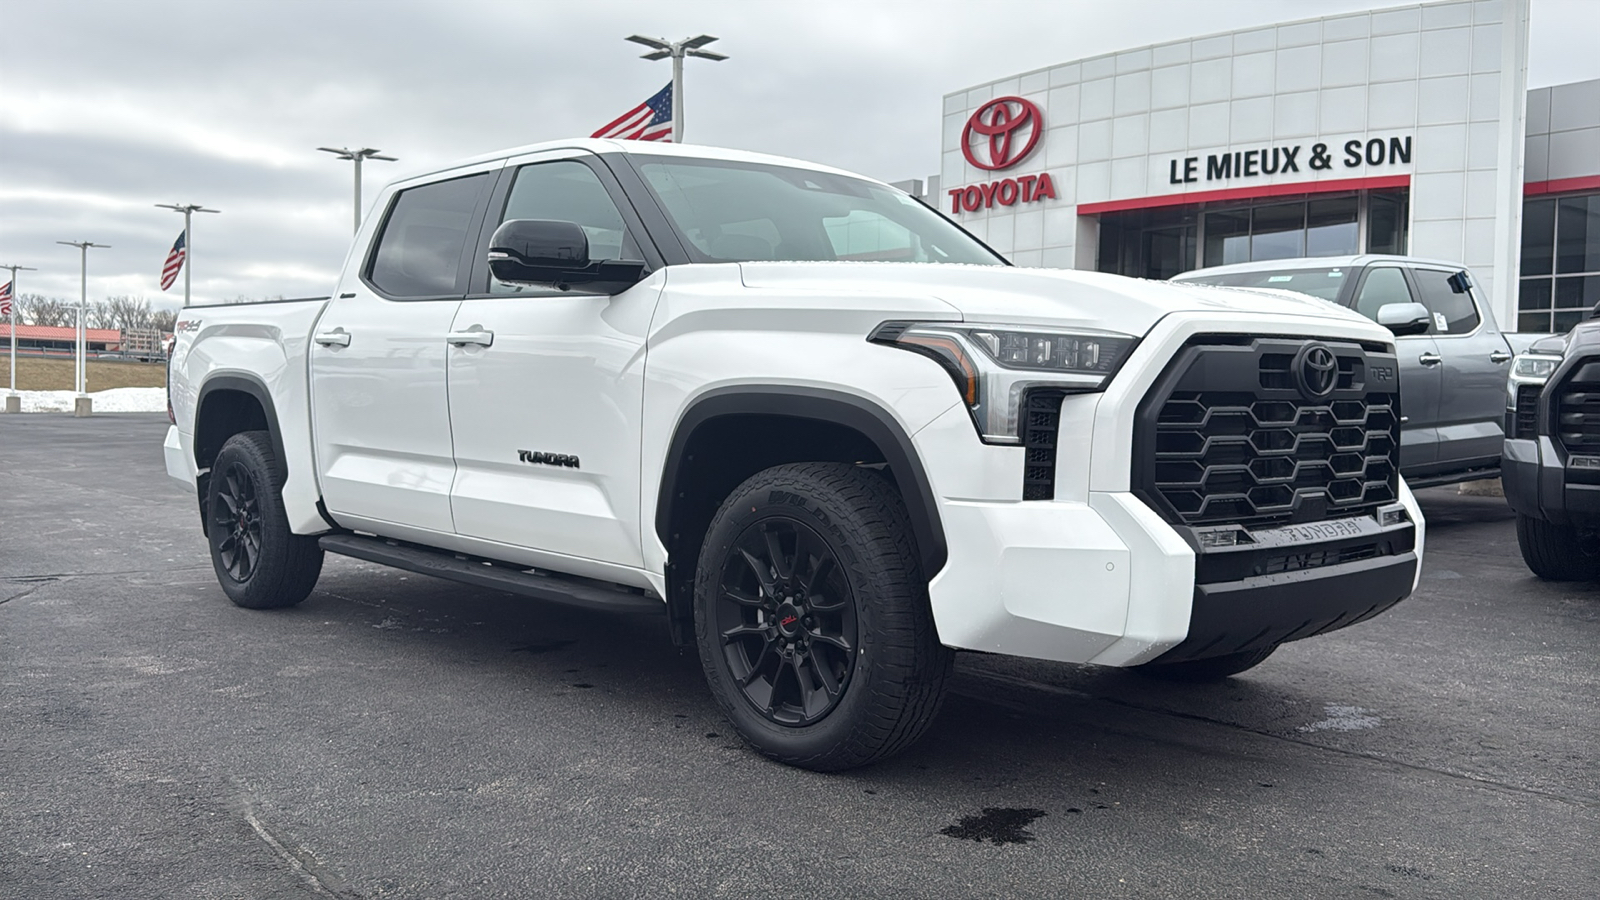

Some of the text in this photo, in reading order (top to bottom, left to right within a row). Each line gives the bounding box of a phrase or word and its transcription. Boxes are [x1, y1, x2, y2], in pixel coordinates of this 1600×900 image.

[1169, 136, 1412, 185] LE MIEUX & SON
[948, 172, 1056, 214] TOYOTA
[1370, 366, 1393, 381] TRD
[517, 449, 580, 469] TUNDRA
[1280, 520, 1362, 541] TUNDRA
